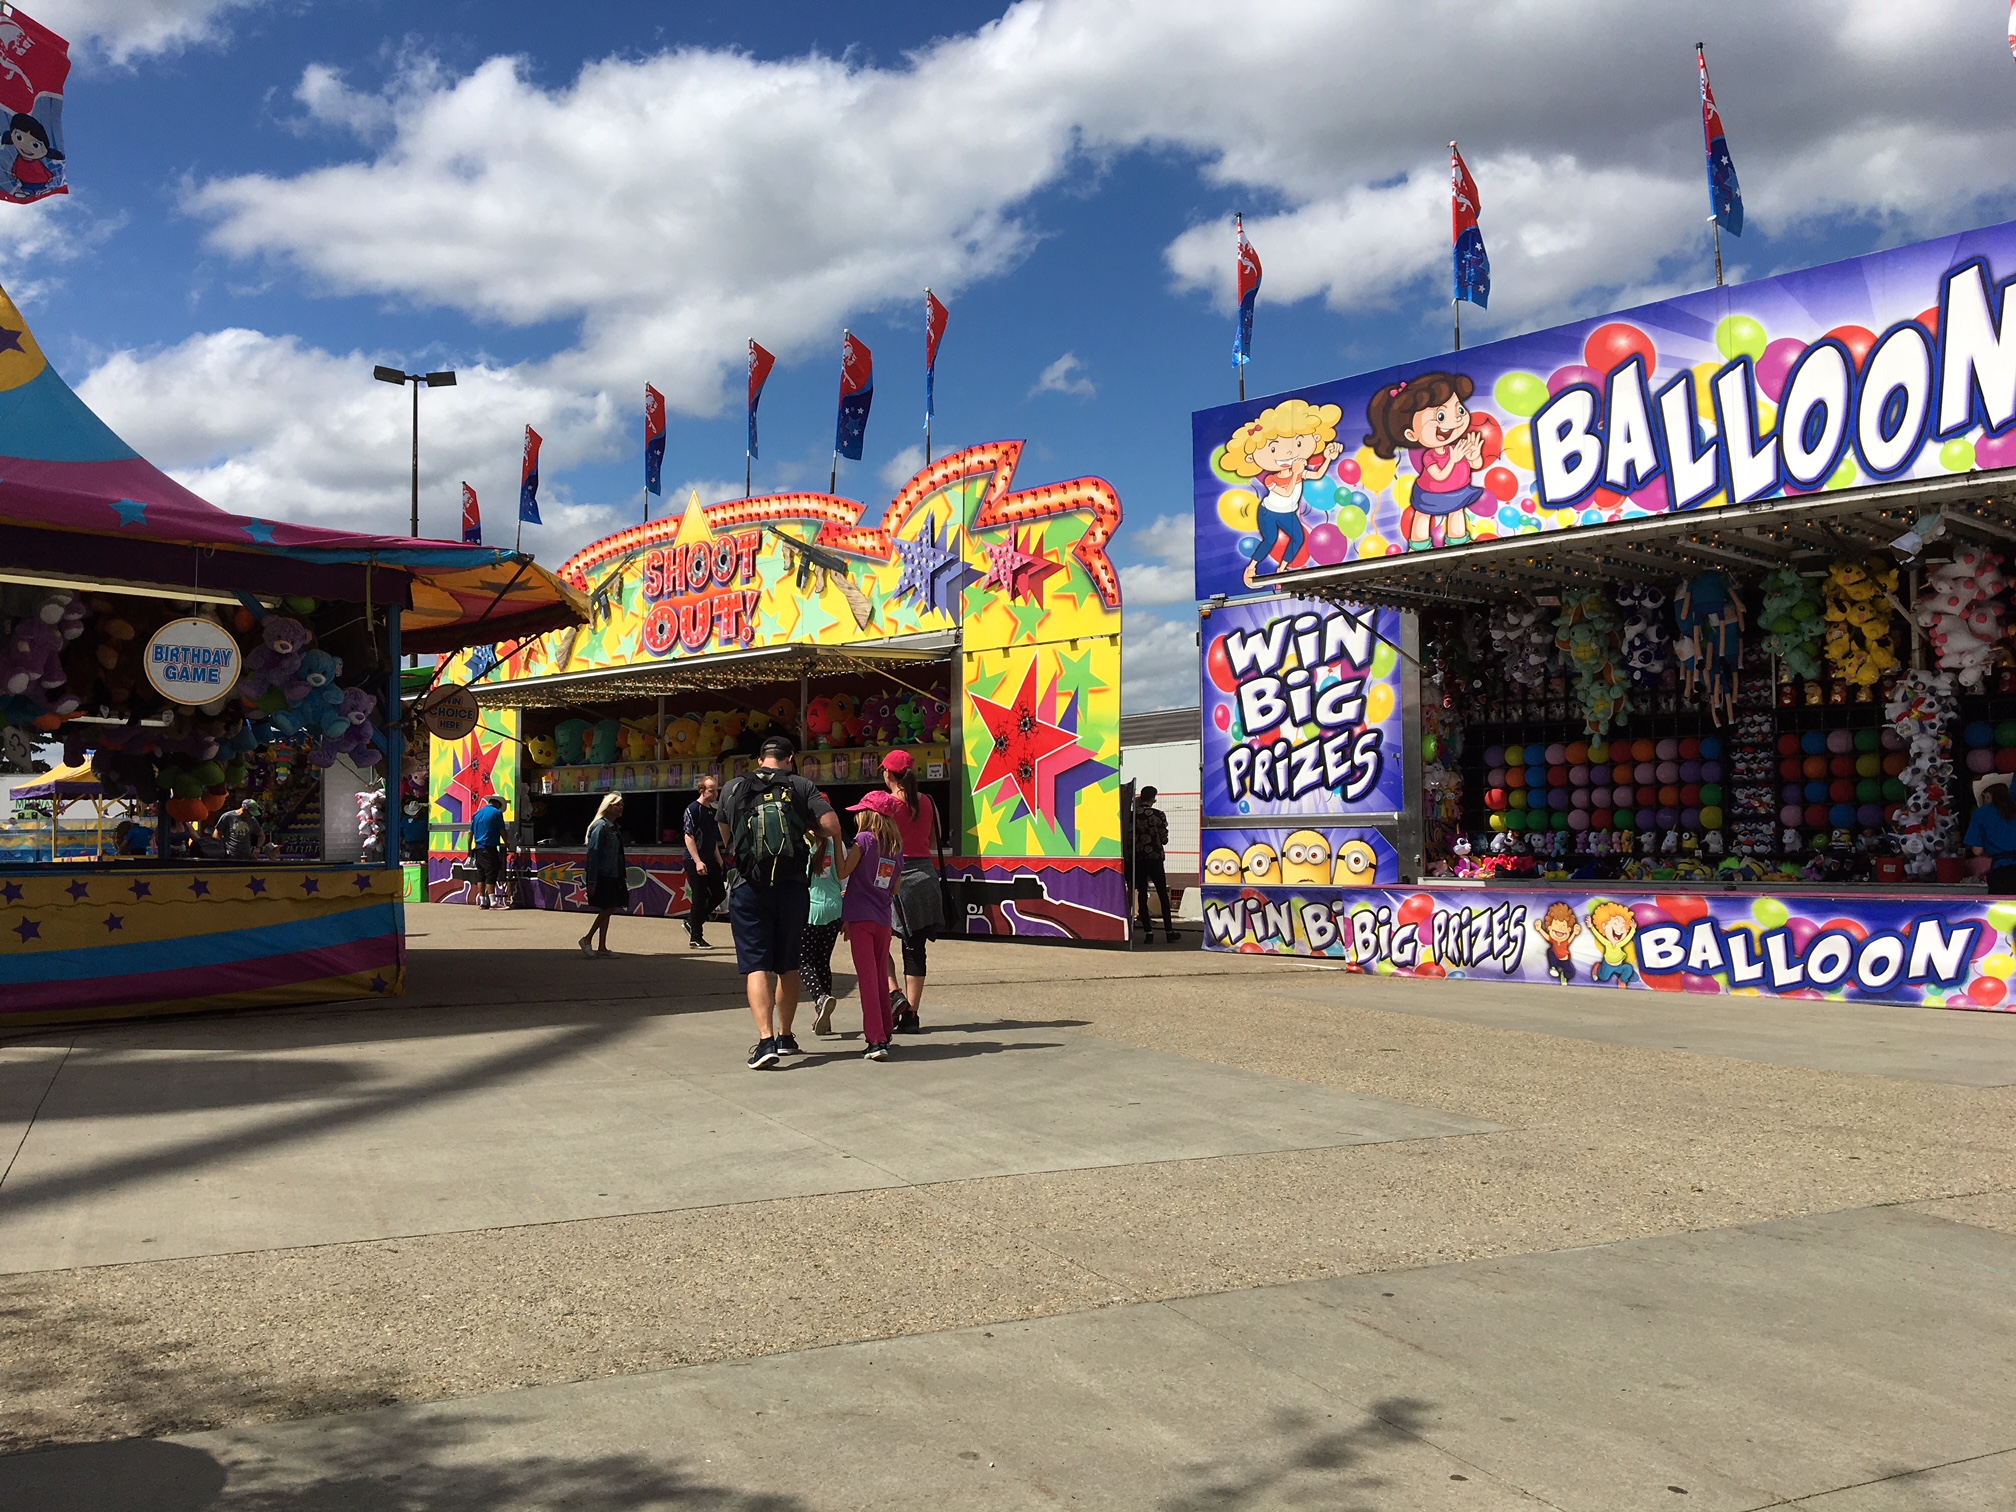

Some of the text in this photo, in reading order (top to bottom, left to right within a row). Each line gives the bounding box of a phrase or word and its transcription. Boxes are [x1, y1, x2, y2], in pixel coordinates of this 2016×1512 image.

[1533, 259, 2016, 509] BALLOON
[643, 531, 761, 598] SHOOT
[643, 590, 760, 652] OUT!
[152, 644, 233, 667] BIRTHDAY
[163, 664, 220, 684] GAME
[429, 706, 474, 719] CHOICE
[439, 719, 461, 729] HERE
[1637, 917, 1974, 989] BALLOON
